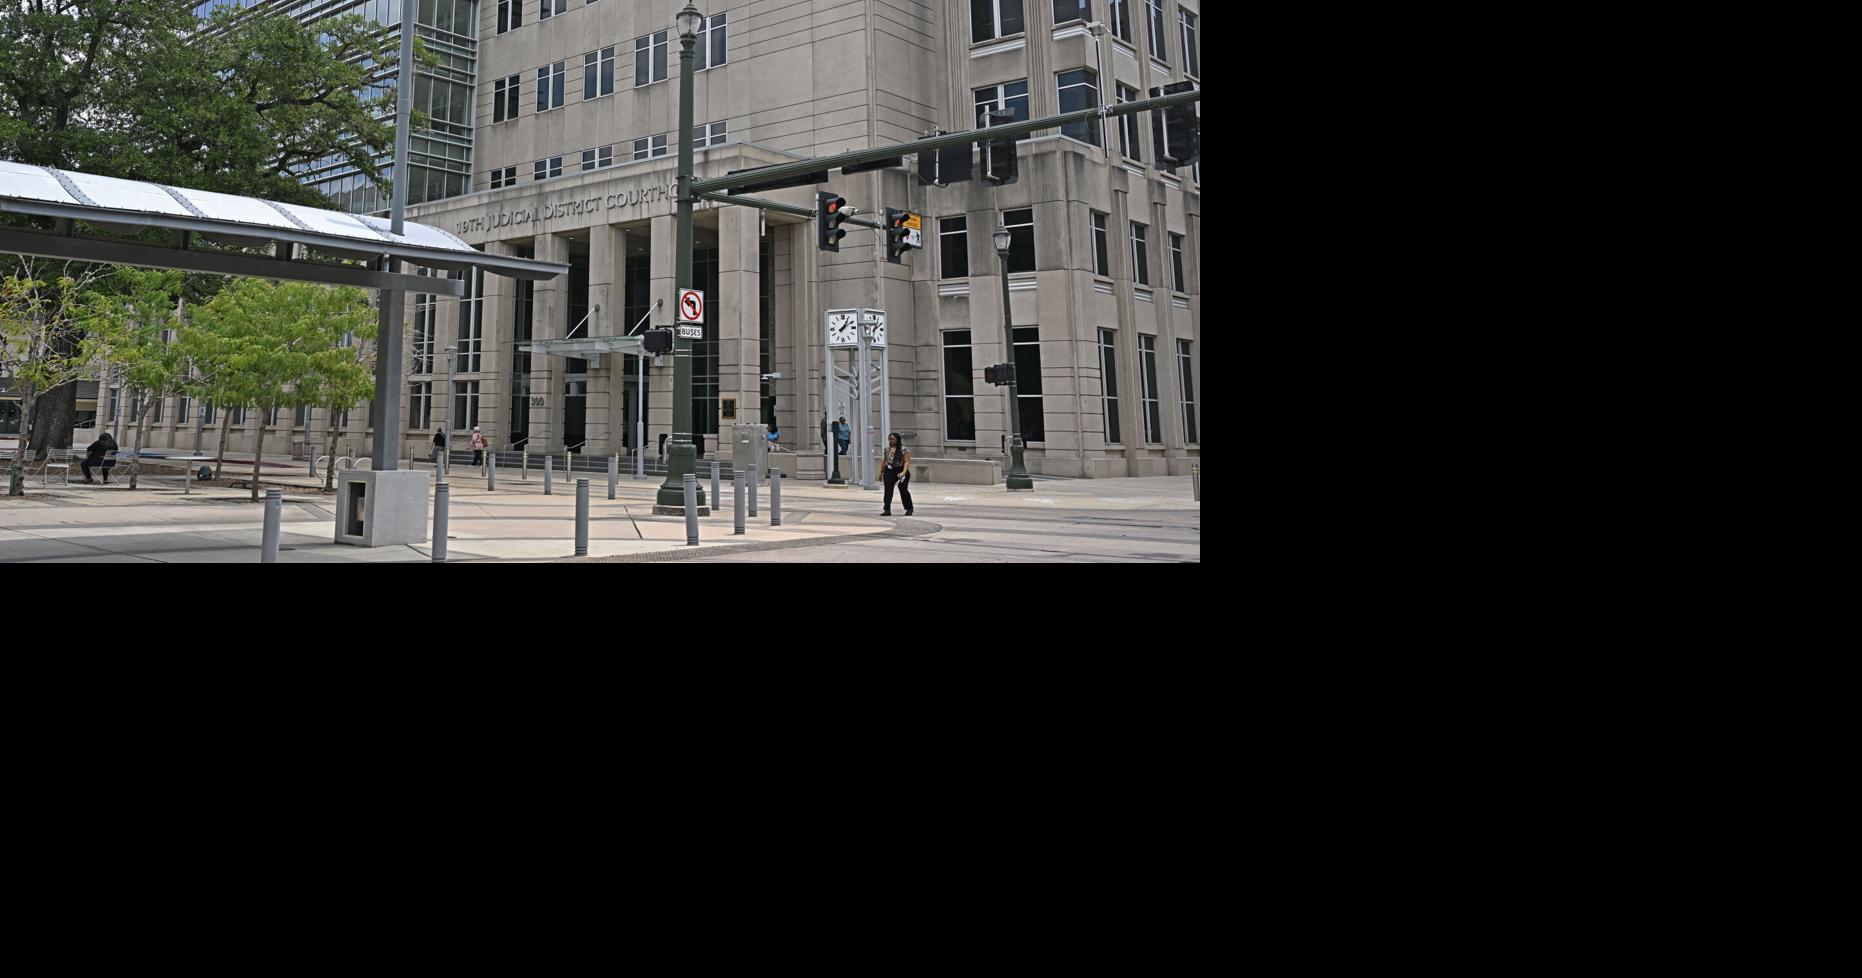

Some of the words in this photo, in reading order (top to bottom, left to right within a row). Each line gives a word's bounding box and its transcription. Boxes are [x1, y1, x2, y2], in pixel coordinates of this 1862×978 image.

[456, 216, 485, 234] 19TH
[486, 207, 541, 232] JUDICIAL
[543, 196, 602, 220] DISTRICT
[606, 183, 678, 210] COURTHO
[681, 327, 701, 337] BUSES
